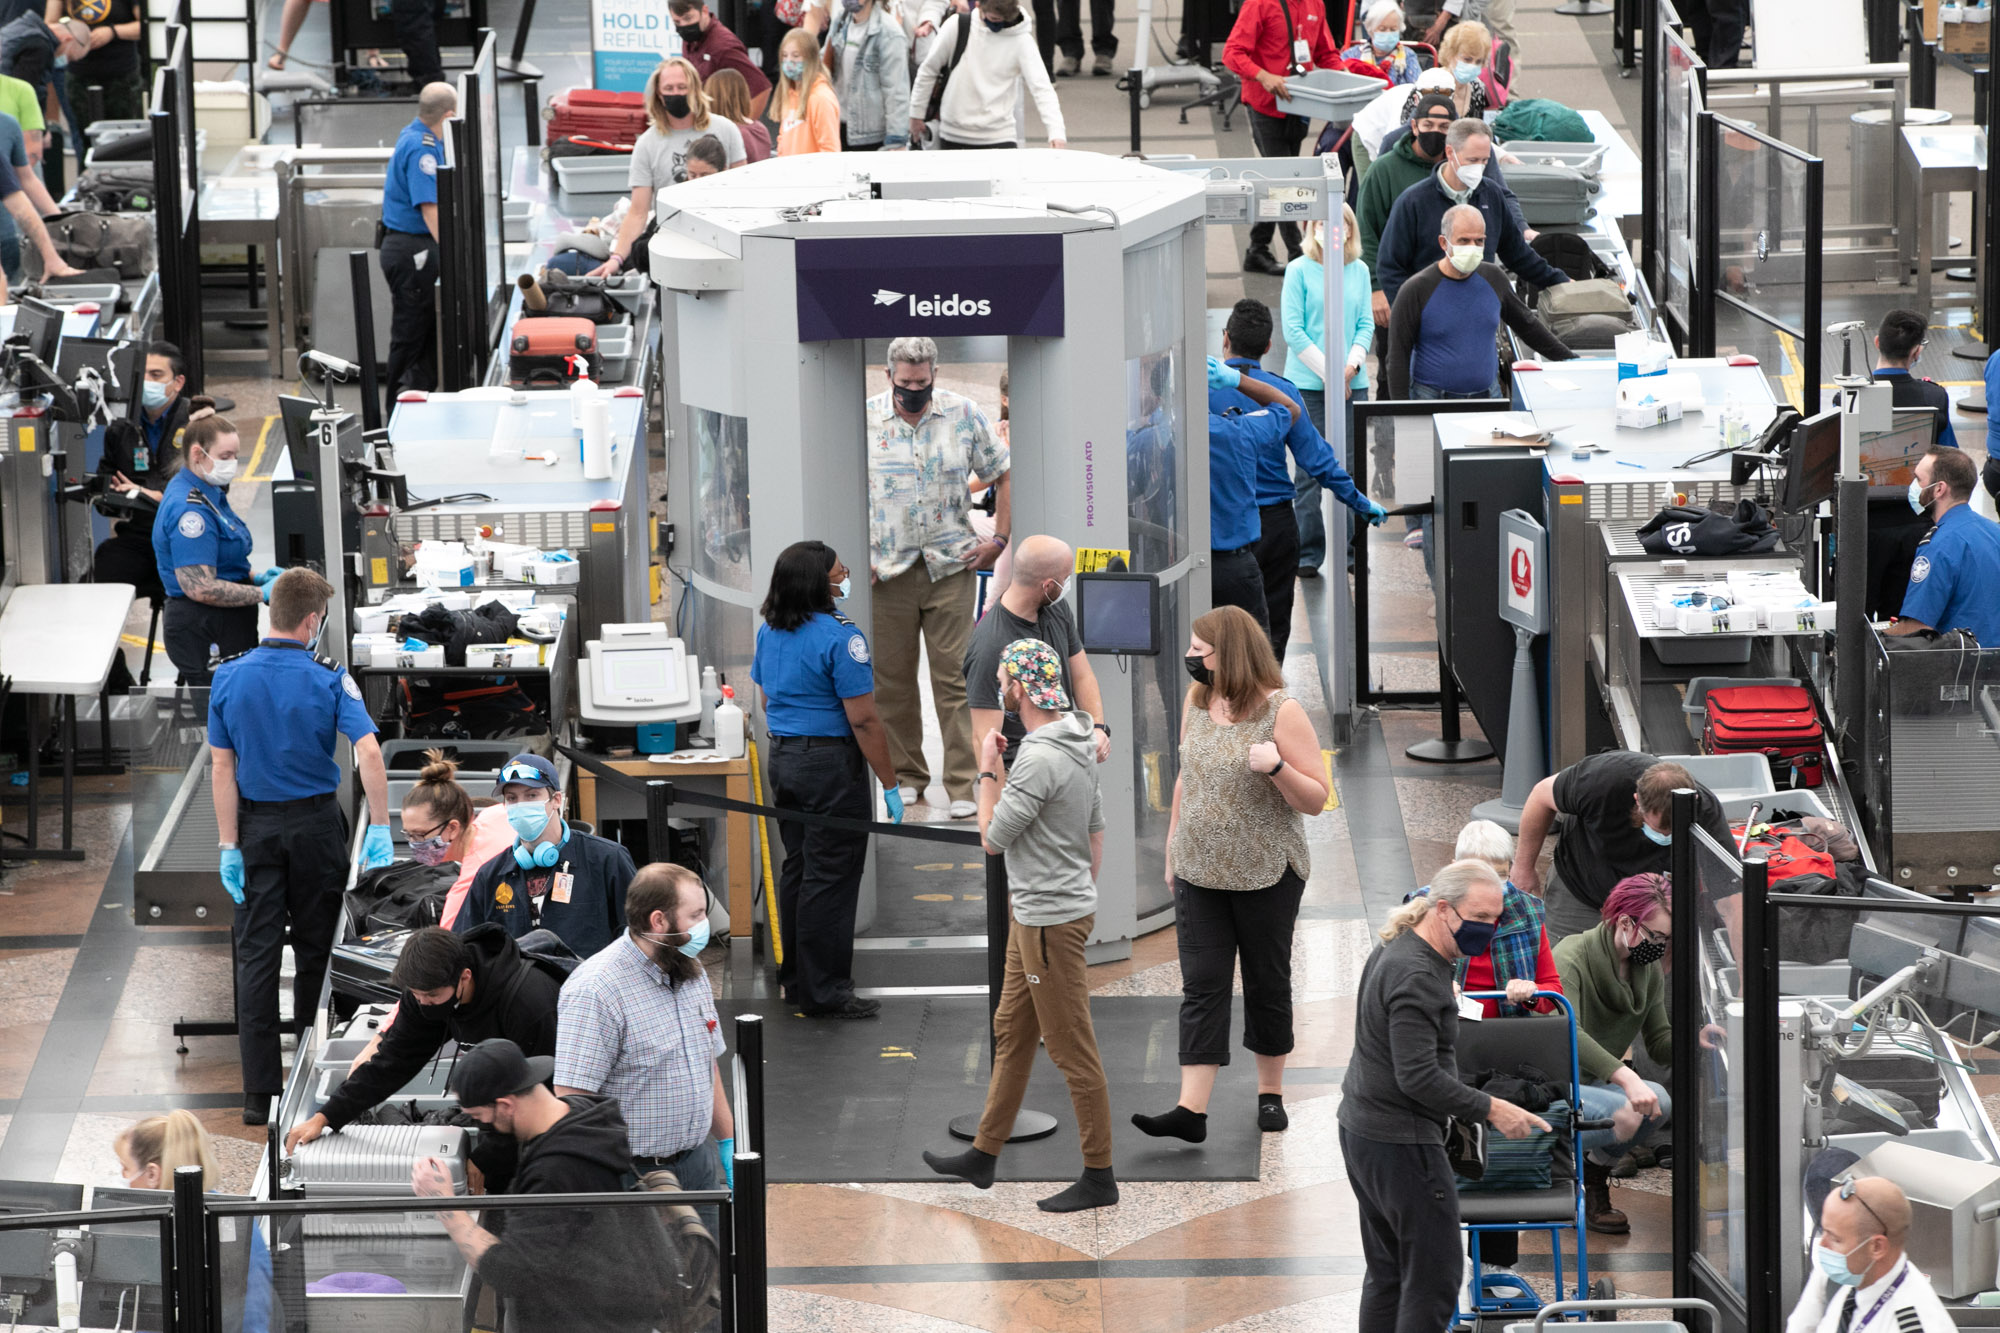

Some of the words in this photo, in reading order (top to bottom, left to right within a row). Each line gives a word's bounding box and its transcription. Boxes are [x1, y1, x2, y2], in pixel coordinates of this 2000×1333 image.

[603, 13, 659, 30] HOLD
[603, 32, 663, 48] REFILL
[909, 293, 991, 317] leidos
[1847, 391, 1857, 413] 7
[322, 423, 332, 446] 6
[1085, 441, 1093, 462] ATD
[1085, 464, 1094, 527] PRO:VISION
